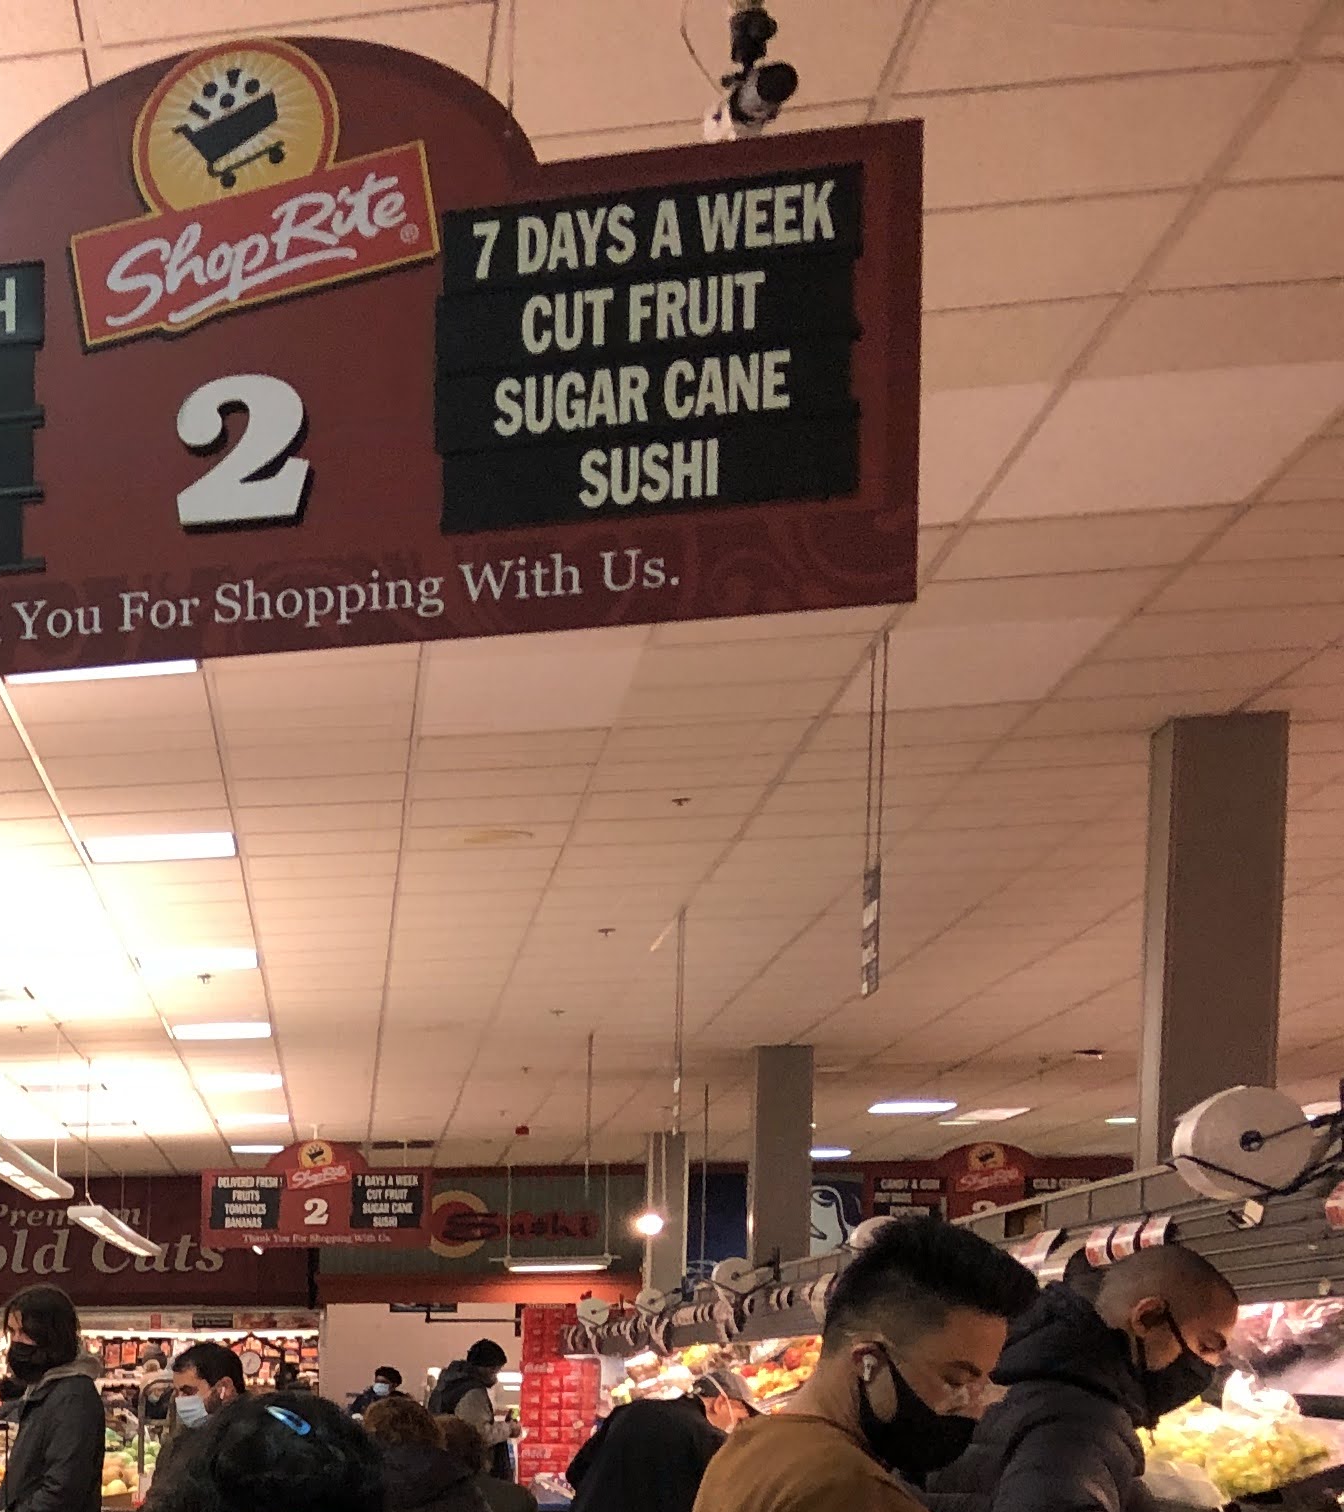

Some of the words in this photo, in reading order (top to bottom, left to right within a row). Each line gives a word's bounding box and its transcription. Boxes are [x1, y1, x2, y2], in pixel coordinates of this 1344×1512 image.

[106, 172, 406, 326] ShopRite
[473, 220, 500, 280] 7
[517, 203, 636, 275] DAYS
[651, 199, 682, 259] A
[698, 180, 835, 253] WEEK
[522, 287, 614, 354] CUT
[628, 271, 766, 343] FRUIT
[494, 365, 649, 436] SUGAR
[664, 348, 792, 420] CANE
[176, 374, 310, 526] 2
[579, 438, 719, 509] SUSHI
[12, 599, 102, 642] You
[117, 590, 195, 632] For
[213, 571, 444, 630] Shopping
[460, 554, 582, 603] With
[600, 548, 681, 590] Us.
[232, 1190, 260, 1201] FRUITS
[365, 1175, 386, 1187] DAYS
[387, 1175, 394, 1186] A
[396, 1175, 419, 1186] WEEK
[384, 1189, 408, 1201] FRUIT
[224, 1203, 266, 1215] TOMATOES
[224, 1216, 262, 1228] BANANAS
[304, 1197, 329, 1225] 2
[362, 1202, 389, 1215] SUGAR
